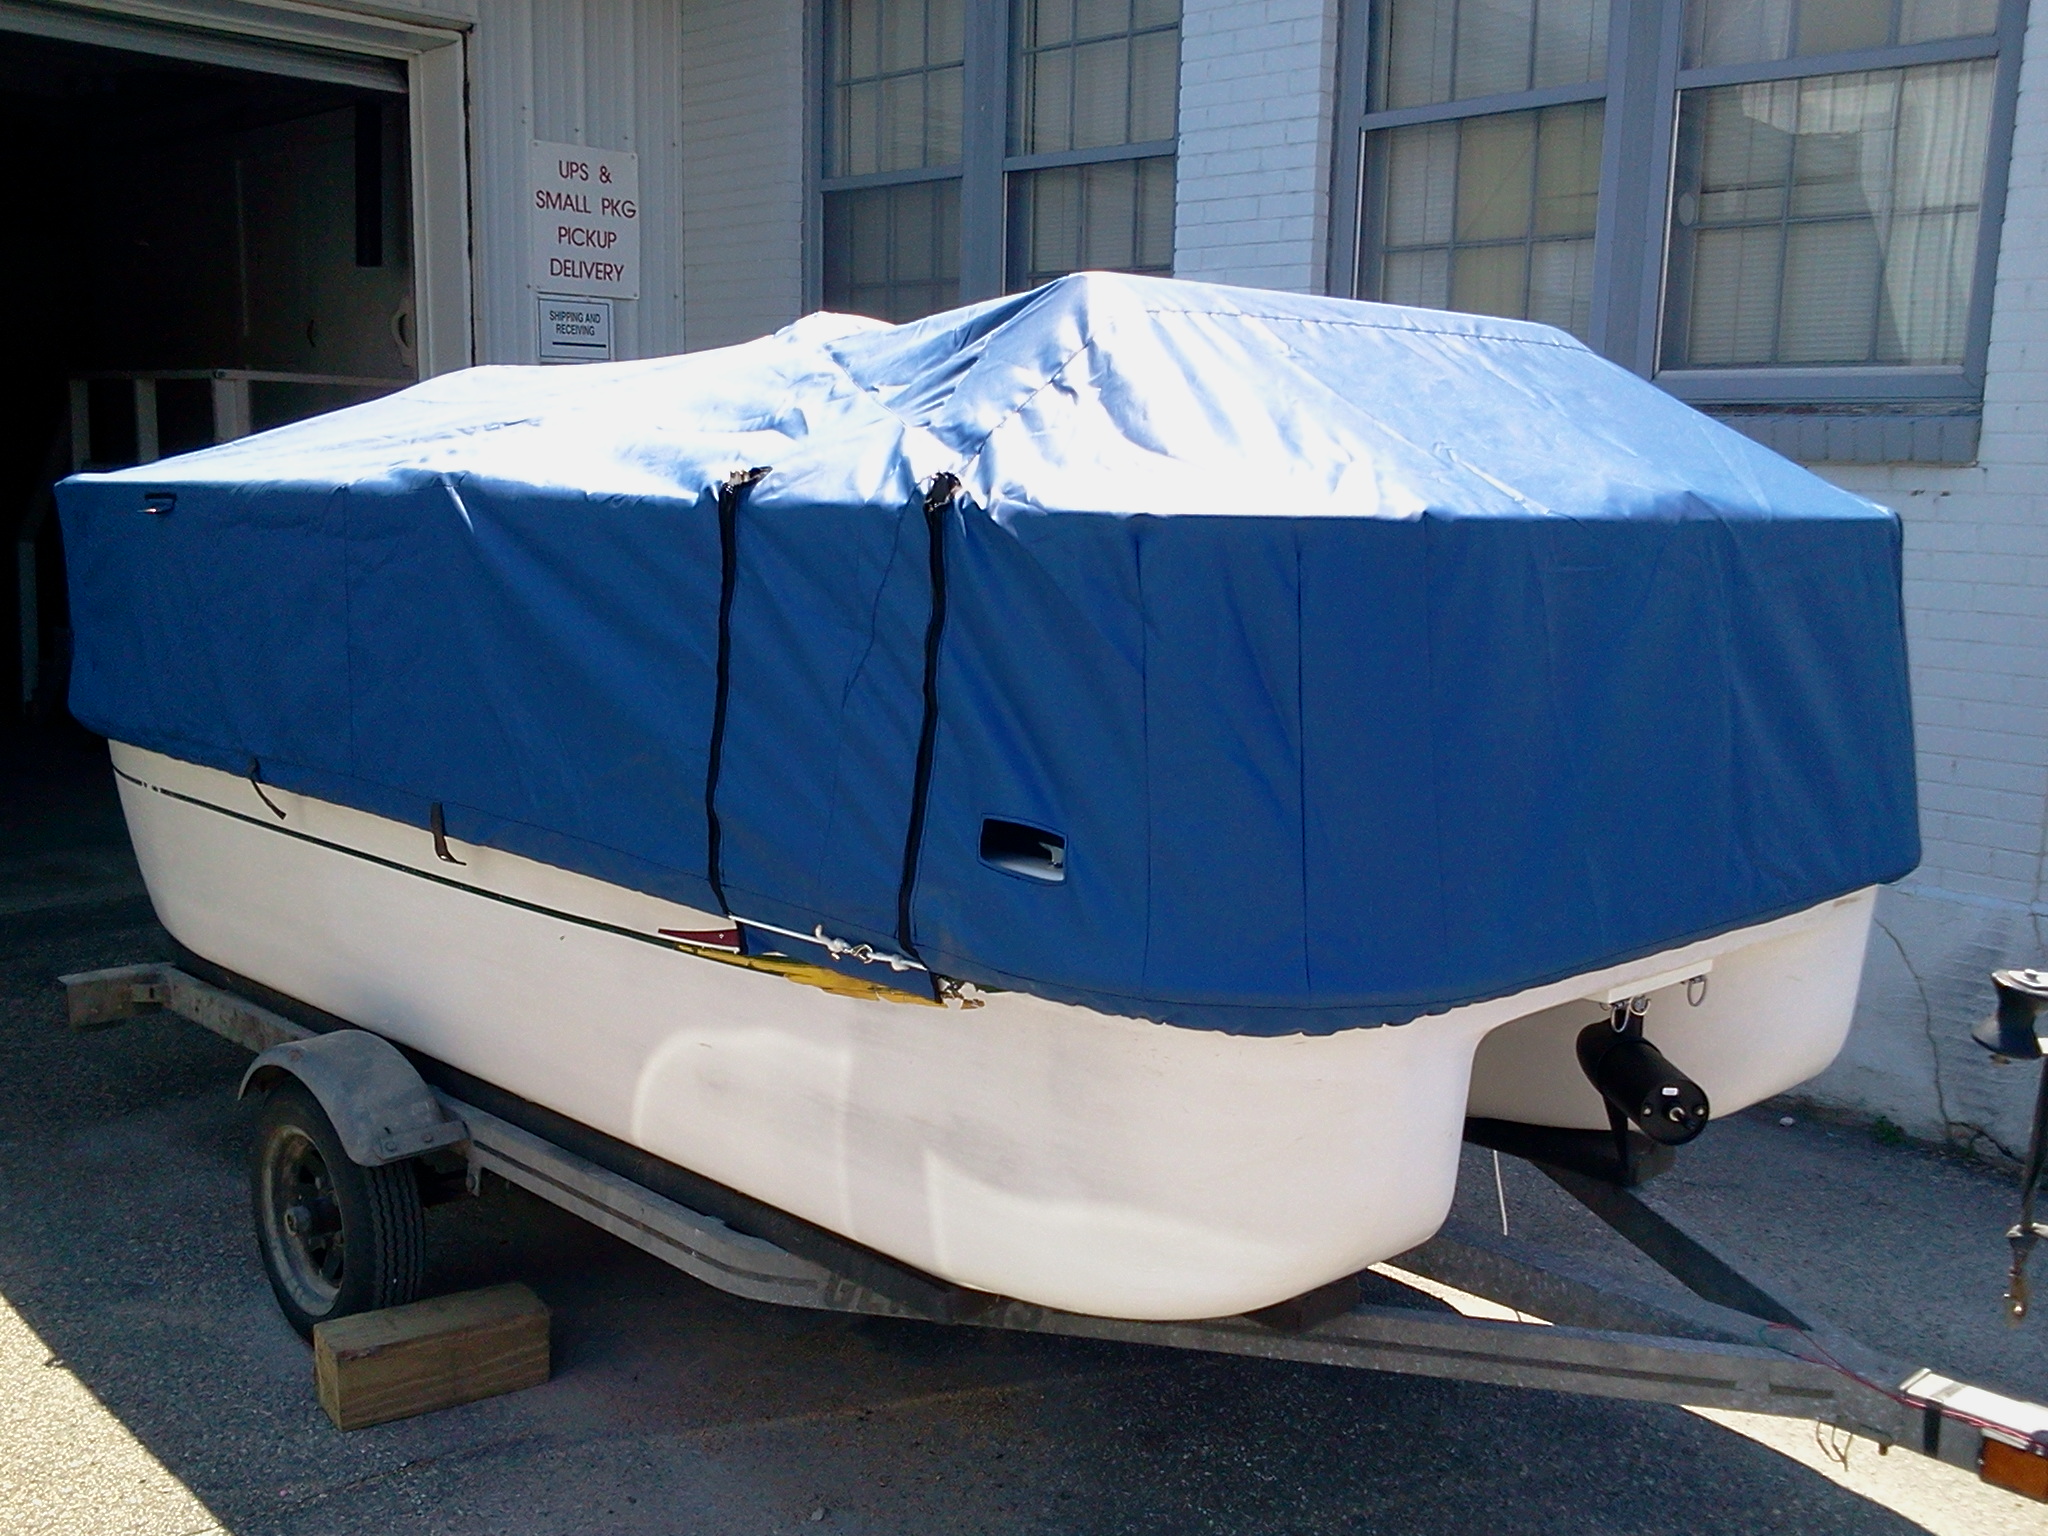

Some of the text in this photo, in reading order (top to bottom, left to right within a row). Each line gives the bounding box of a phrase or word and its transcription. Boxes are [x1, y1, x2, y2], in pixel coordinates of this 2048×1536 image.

[559, 160, 612, 184] UPS &
[536, 190, 637, 219] SMALL PKG
[558, 226, 617, 248] PICKUP
[550, 258, 624, 281] DELIVERY
[549, 310, 601, 324] SHIPPING AND
[556, 324, 595, 336] RECEIVING
